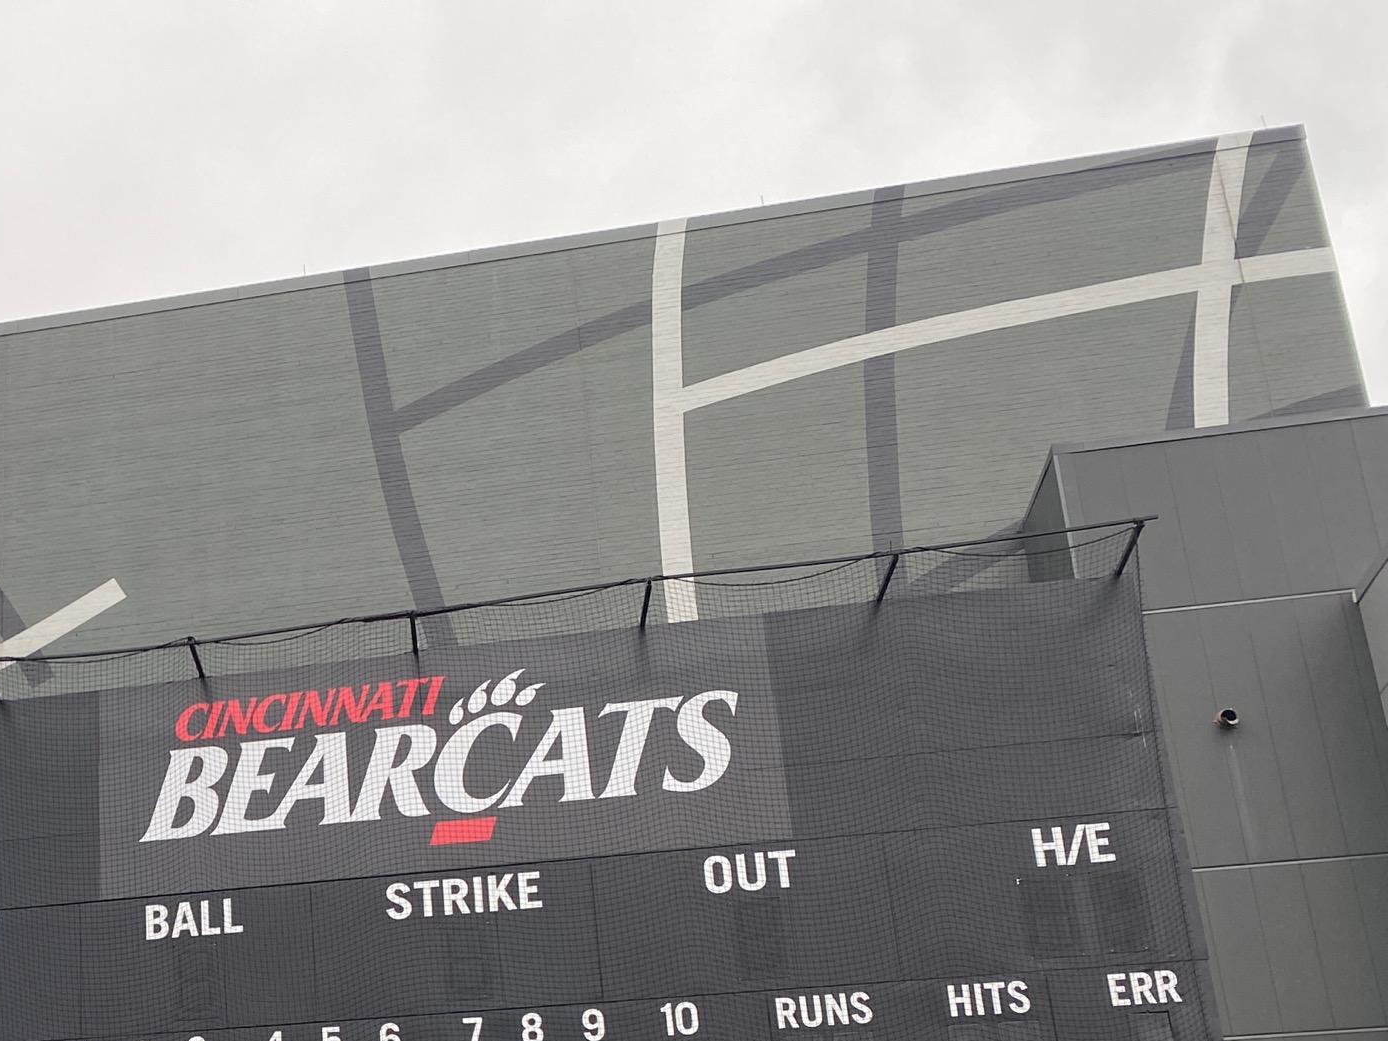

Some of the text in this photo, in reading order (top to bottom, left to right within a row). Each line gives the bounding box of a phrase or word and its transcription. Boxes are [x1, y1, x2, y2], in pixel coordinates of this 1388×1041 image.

[176, 676, 445, 742] CINCINNATI
[139, 688, 738, 842] BEARCATS
[1031, 822, 1116, 867] H/E
[386, 871, 542, 920] STRIKE
[704, 850, 796, 893] OUT
[145, 898, 244, 941] BALL
[581, 1008, 605, 1041] 9
[660, 1001, 700, 1037] 10
[775, 991, 873, 1029] RUNS
[947, 980, 1032, 1017] HITS
[1106, 970, 1183, 1006] ERR
